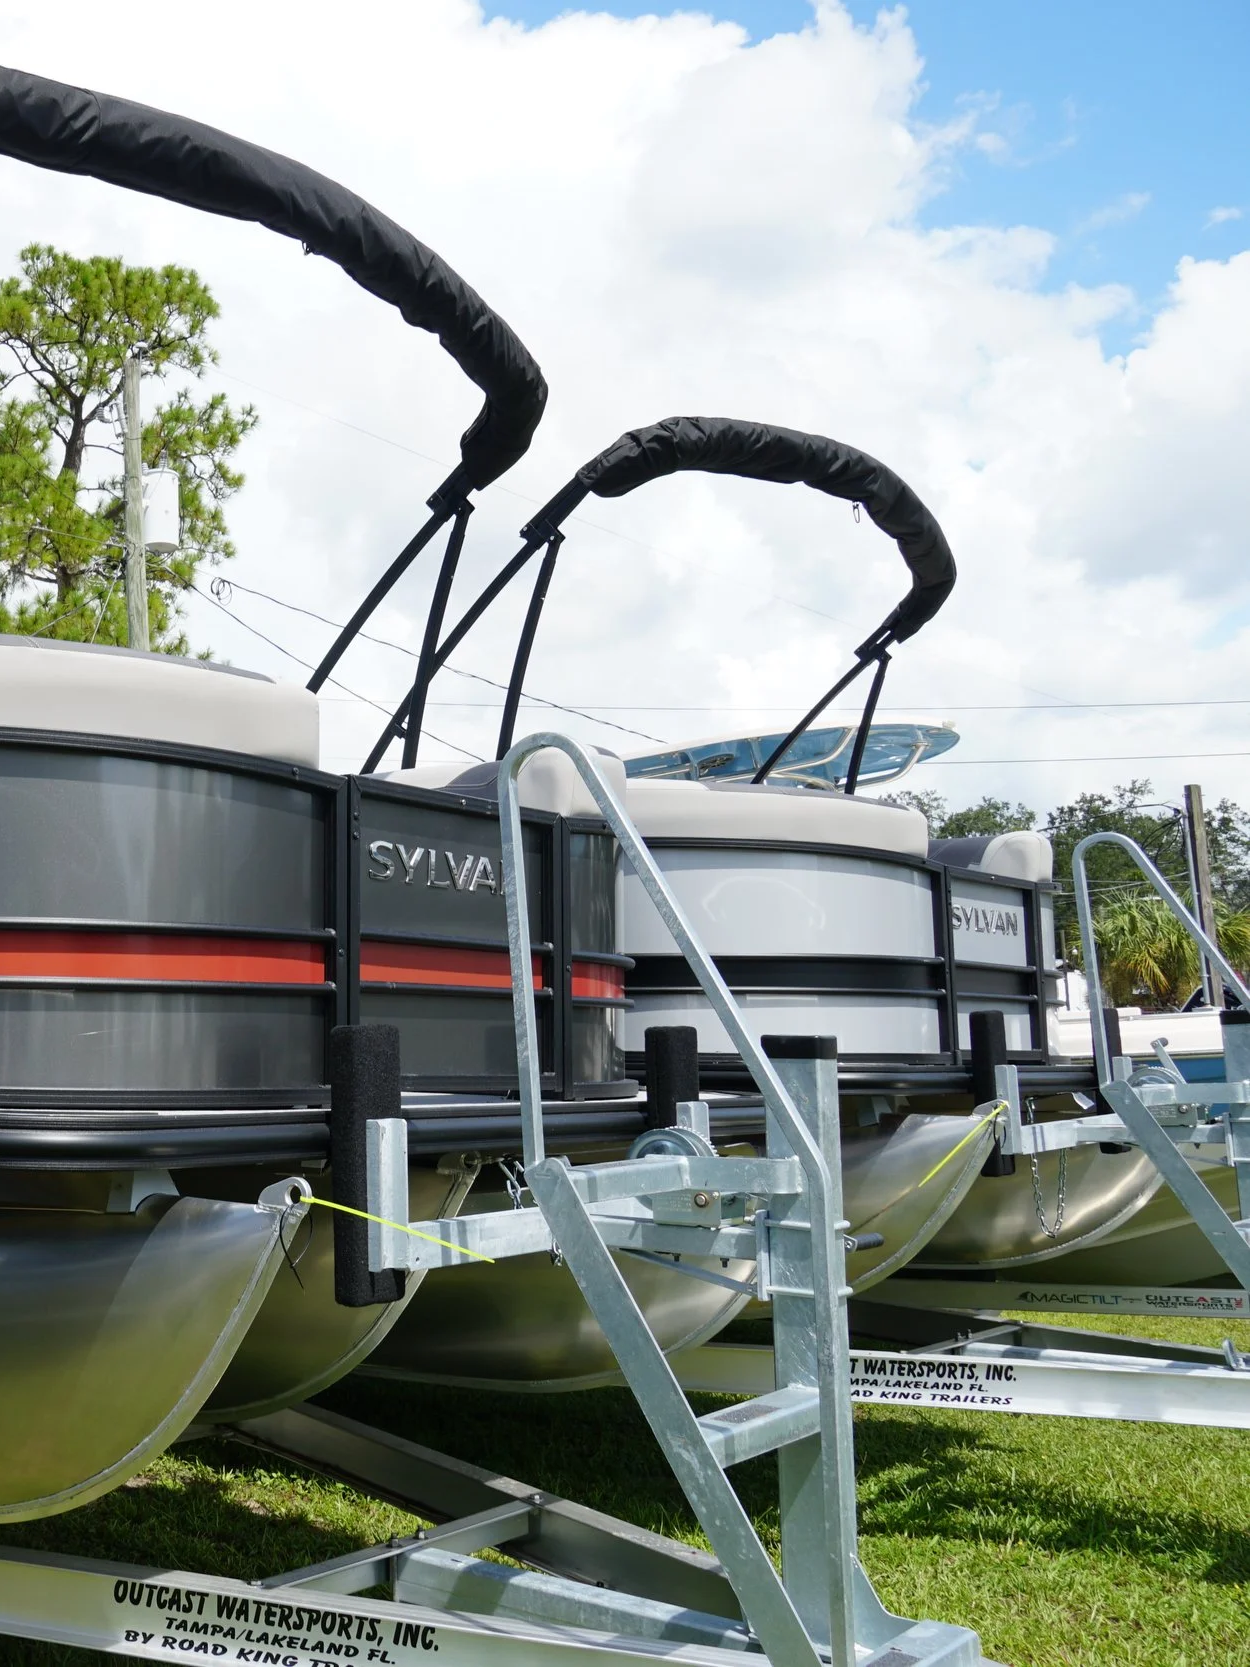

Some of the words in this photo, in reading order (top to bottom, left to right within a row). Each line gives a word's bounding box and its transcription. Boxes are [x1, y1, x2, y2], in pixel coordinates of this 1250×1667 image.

[368, 840, 506, 896] SYLVA
[951, 904, 1018, 937] SYLVAN
[1029, 1292, 1123, 1305] MAGICTILT
[1145, 1294, 1236, 1304] OUTCAST
[850, 1377, 963, 1392] MPA/LAKELAND
[969, 1383, 989, 1392] FL.
[863, 1359, 979, 1382] WATERSPORTS,
[985, 1364, 1017, 1382] INC.
[851, 1389, 873, 1398] AD
[880, 1391, 922, 1400] KING
[930, 1393, 1013, 1405] TRAILERS
[113, 1579, 210, 1616] OUTCAST
[216, 1594, 384, 1647] WATERSPORTS,
[392, 1622, 439, 1652] INC.
[124, 1629, 155, 1645] BY
[161, 1635, 228, 1656] ROAD
[236, 1647, 299, 1667] KING
[165, 1616, 360, 1658] TAMPA/LAKELAND
[367, 1648, 396, 1665] FL.
